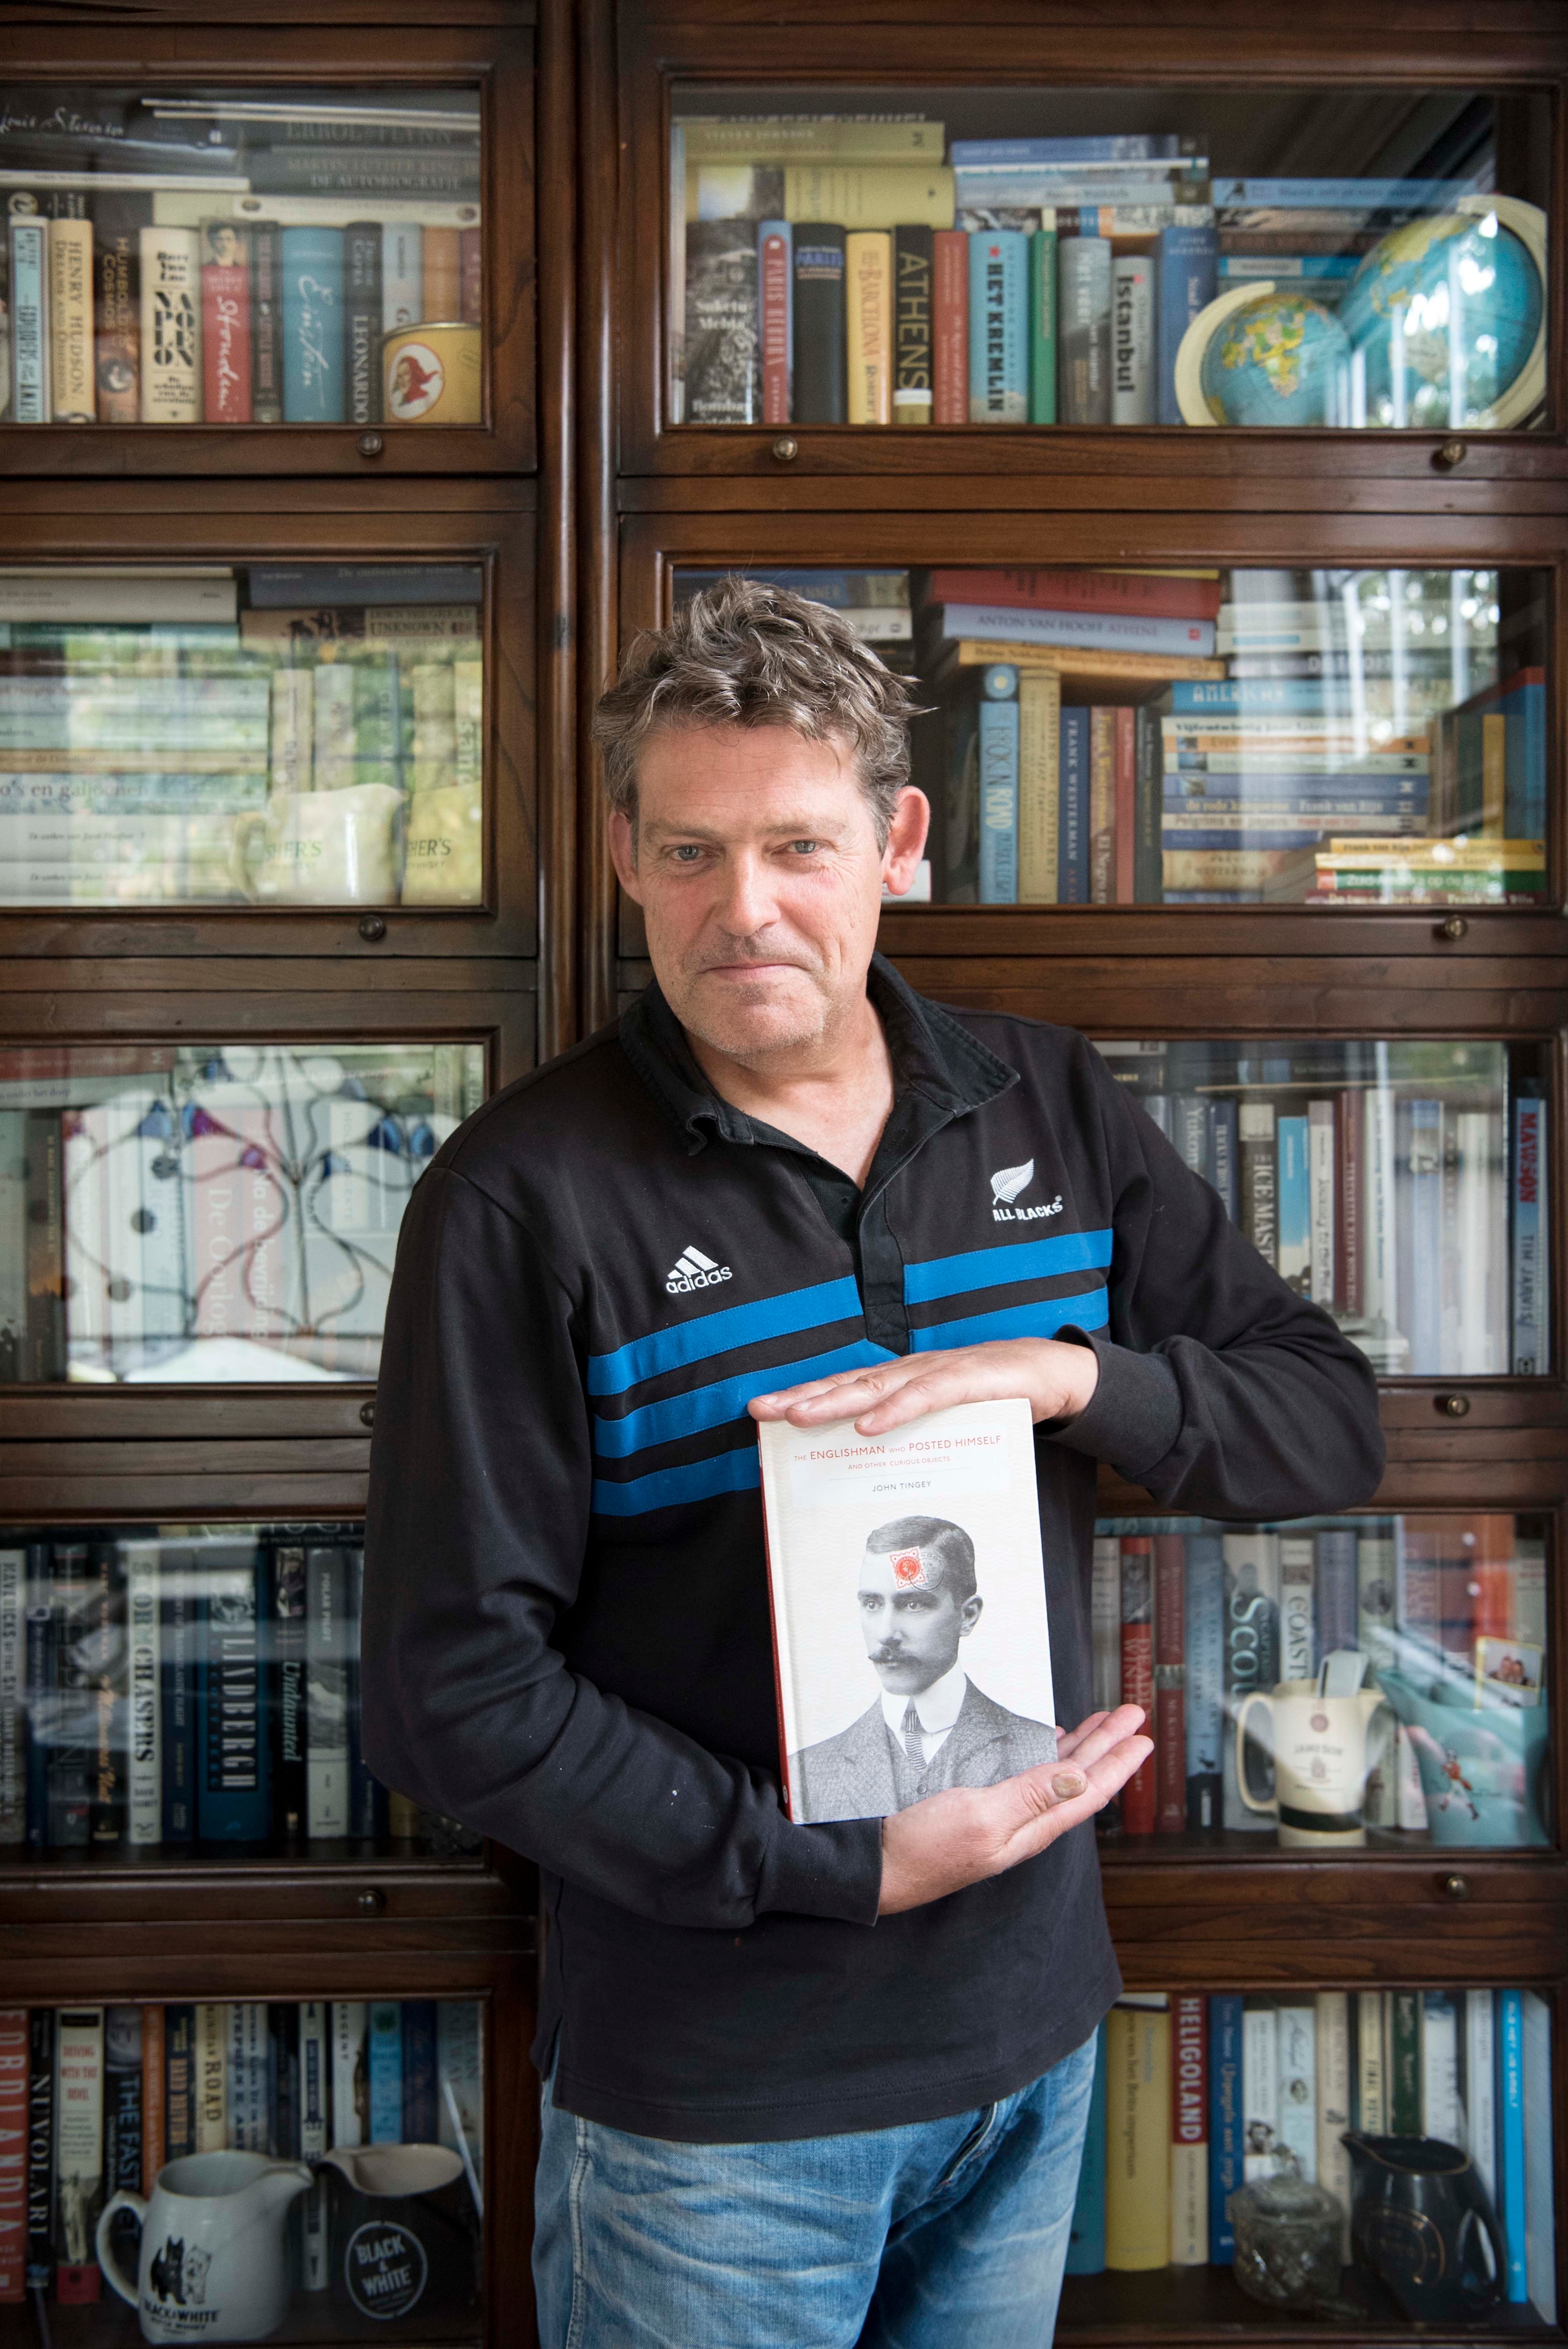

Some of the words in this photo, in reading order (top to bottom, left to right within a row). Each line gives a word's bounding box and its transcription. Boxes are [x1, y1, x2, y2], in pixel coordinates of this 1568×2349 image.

[68, 241, 83, 305] HENRY
[987, 262, 1004, 306] HET
[899, 252, 929, 389] ATHENS
[1116, 276, 1136, 392] Istanbul
[68, 315, 85, 395] HUDSON
[353, 316, 370, 424] LEONARDO
[987, 312, 1005, 412] KREMLIN
[984, 788, 1014, 830] ROAD
[1185, 1106, 1204, 1165] Yukon
[1519, 1112, 1537, 1204] MAWSON
[209, 1188, 233, 1227] De
[1254, 1165, 1275, 1198] ICE
[252, 1206, 274, 1232] de
[992, 1208, 1016, 1222] ALL
[1015, 1201, 1063, 1221] BLACKS
[1254, 1203, 1275, 1265] MAST
[1522, 1235, 1534, 1261] TIM
[665, 1265, 733, 1294] adidas
[1520, 1266, 1536, 1324] JARVIS
[810, 1445, 885, 1461] ENGLISHMAN
[909, 1440, 952, 1452] POSTED
[955, 1435, 1001, 1448] HIMSELF
[889, 1459, 920, 1467] CURIOUS
[921, 1456, 951, 1464] OBJECTS
[872, 1483, 897, 1492] JOHN
[900, 1481, 932, 1490] TINGEY
[134, 1647, 156, 1762] CHASERS
[222, 1638, 256, 1788] LINDBERGH
[282, 1660, 302, 1763] Undaunted
[205, 2060, 223, 2122] ROAD
[1179, 1997, 1203, 2141] HELIGOLAND
[119, 2079, 139, 2124] THE
[29, 2073, 51, 2236] NUVOLARI
[118, 2131, 140, 2193] FAST
[356, 2235, 406, 2264] BLACK
[362, 2265, 412, 2297] WHITE
[176, 2309, 219, 2324] WHITE
